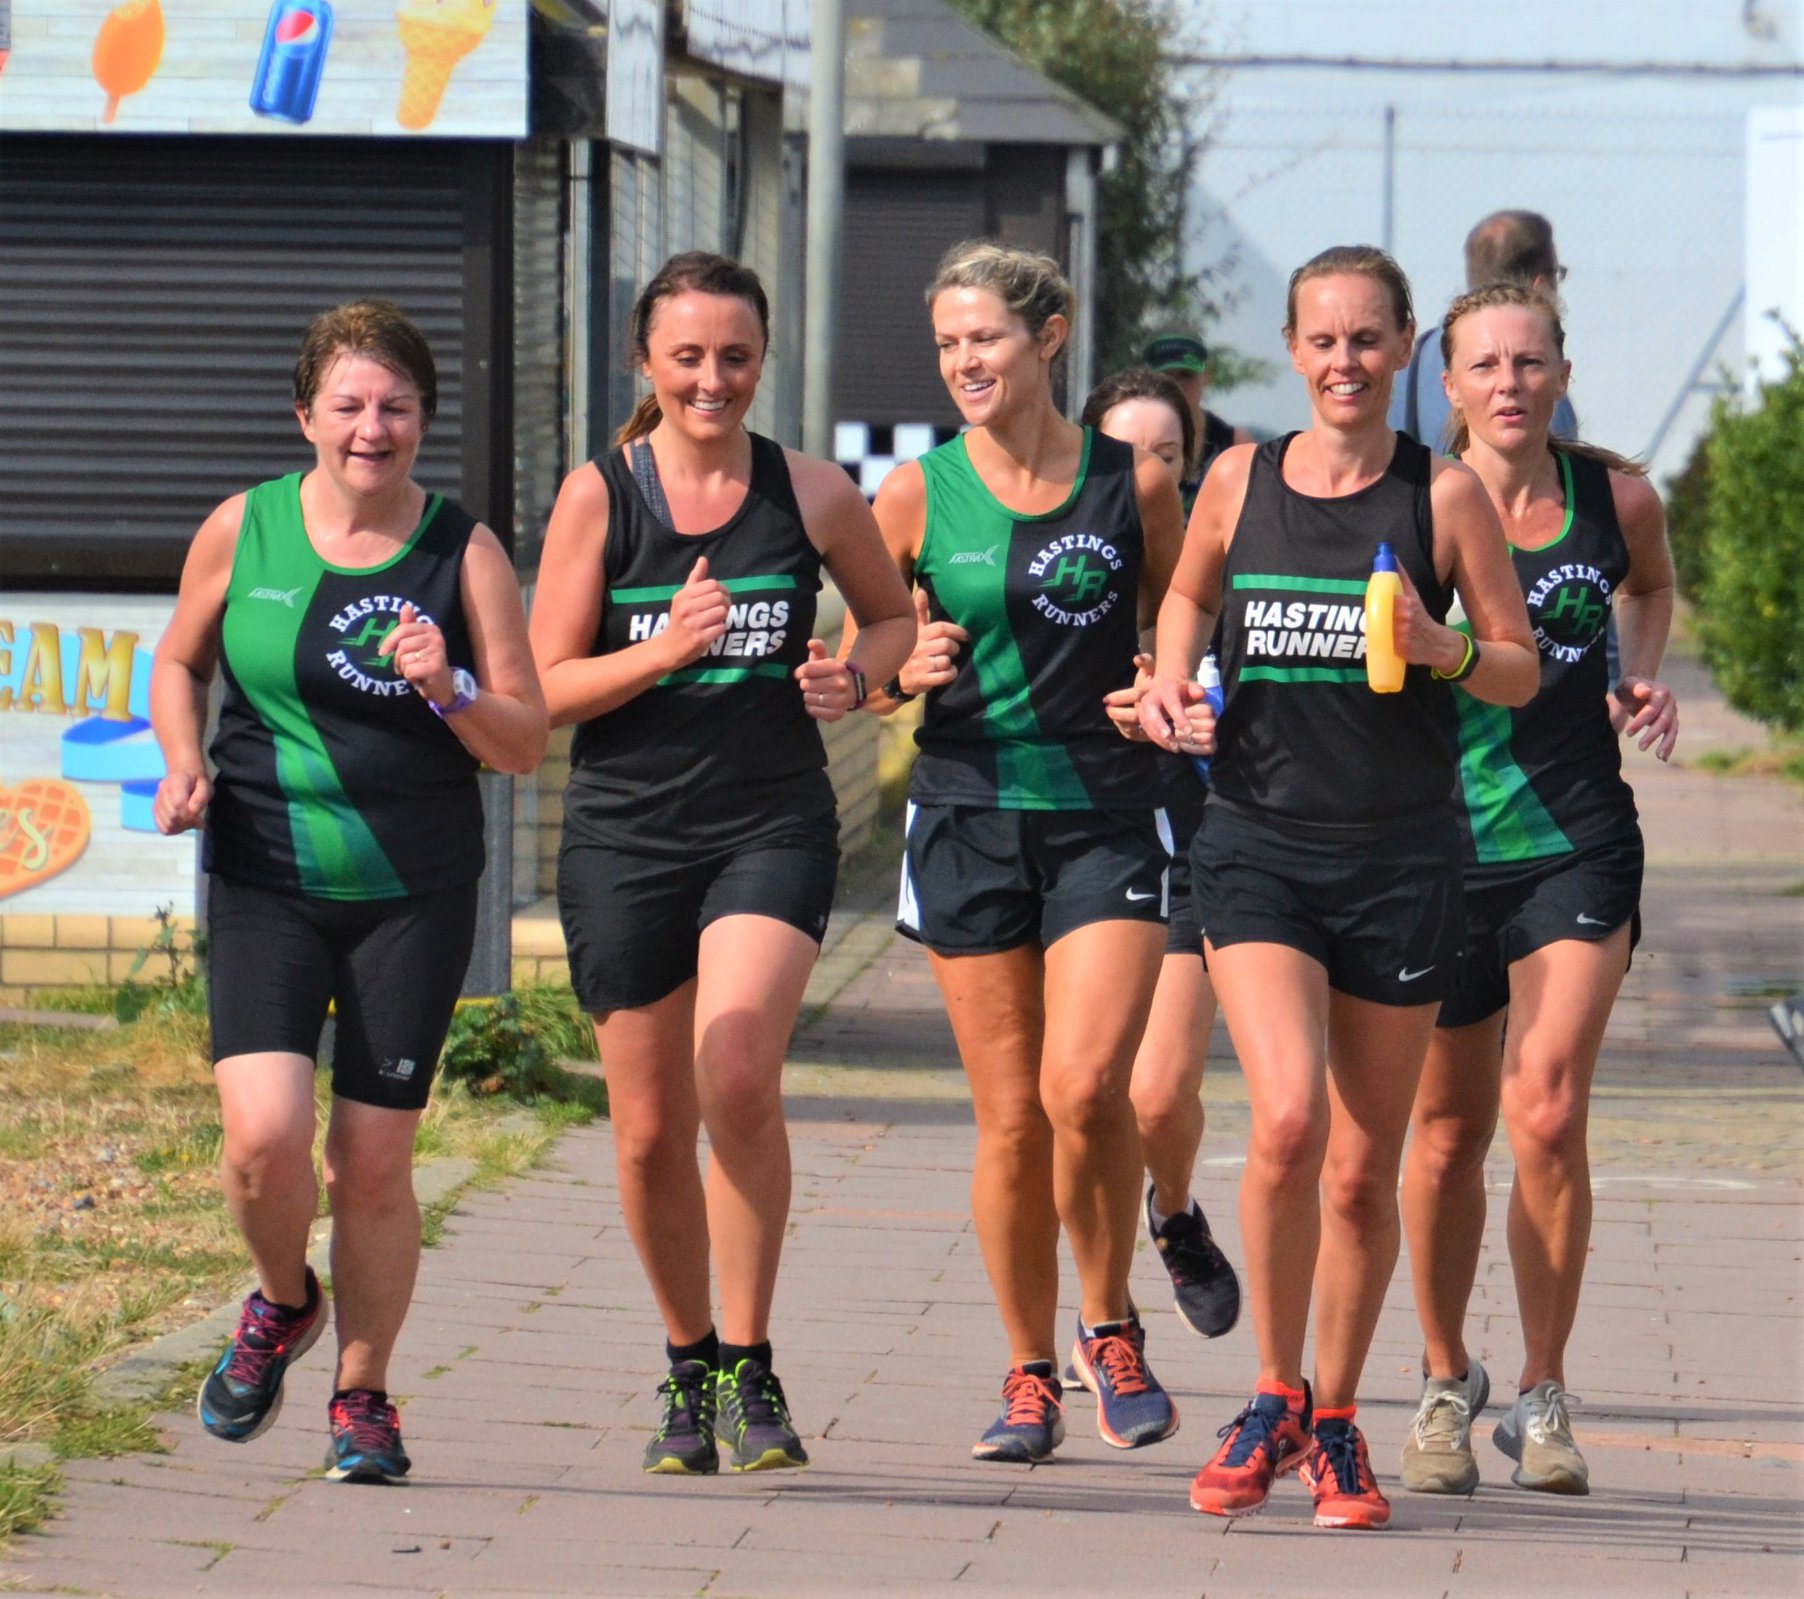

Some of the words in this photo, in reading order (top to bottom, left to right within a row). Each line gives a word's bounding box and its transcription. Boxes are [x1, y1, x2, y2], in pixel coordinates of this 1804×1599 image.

[1028, 533, 1123, 577] HASTINGS
[1044, 554, 1108, 602] HR
[329, 595, 434, 633] HASTI
[629, 600, 790, 641] HANGS
[1031, 589, 1119, 627] RUNNERS
[1244, 601, 1367, 633] HASTIN
[702, 630, 788, 657] NERS
[1246, 630, 1367, 659] RUNNE
[326, 649, 424, 697] RUNNE
